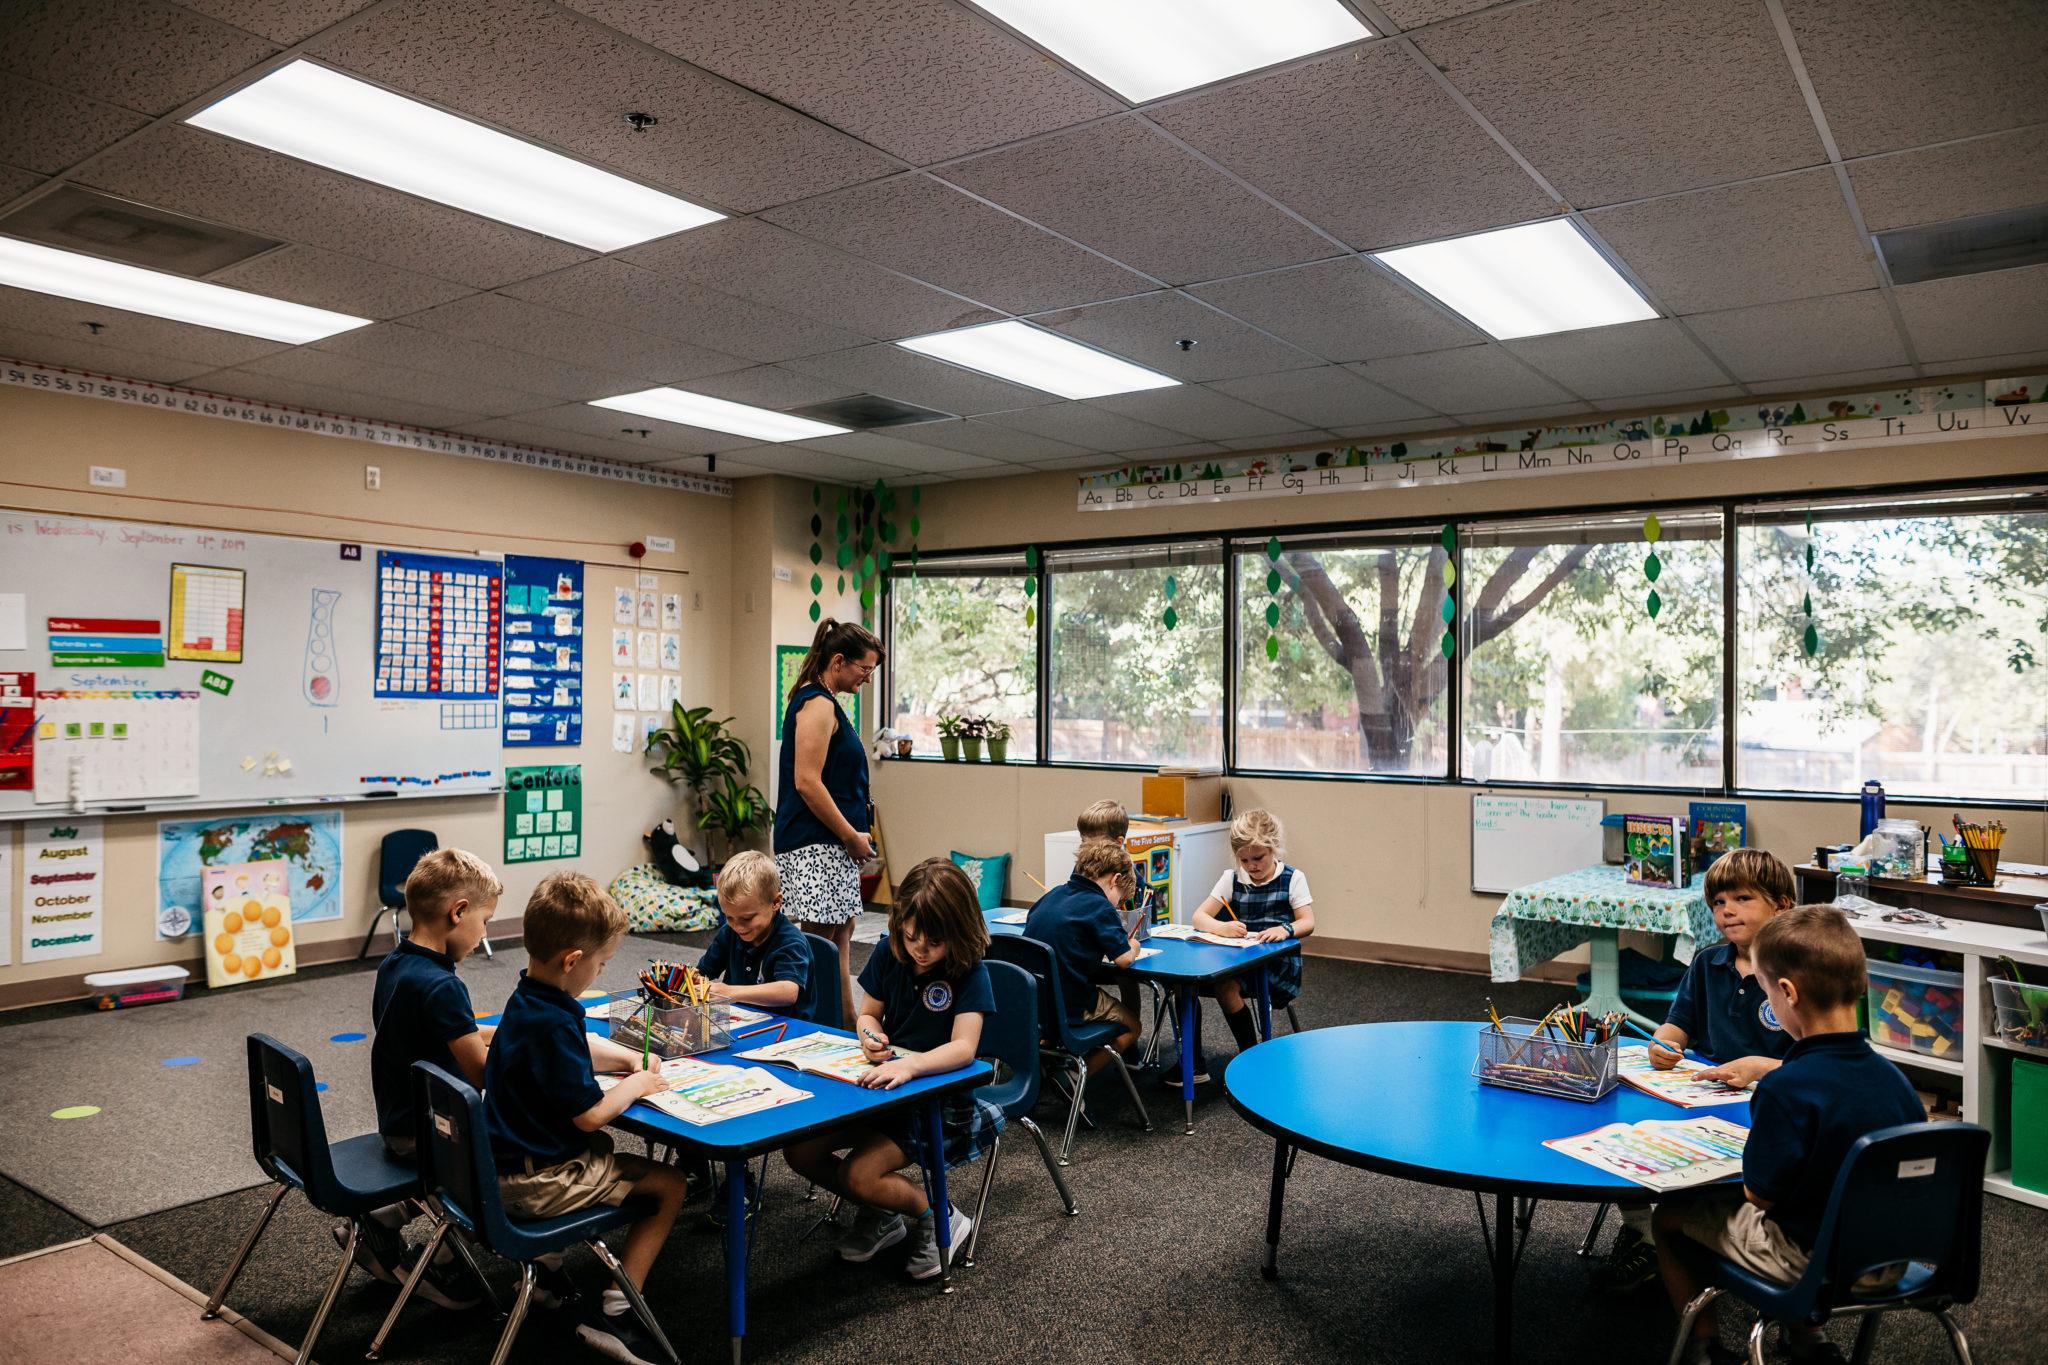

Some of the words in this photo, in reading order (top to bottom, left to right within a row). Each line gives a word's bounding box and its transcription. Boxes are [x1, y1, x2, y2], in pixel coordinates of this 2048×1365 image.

[8, 369, 25, 382] 54
[32, 374, 49, 386] 55
[55, 378, 72, 390] 56
[78, 381, 94, 394] 57
[100, 384, 116, 398] 58
[122, 388, 138, 400] 59
[142, 392, 159, 404] 60
[165, 396, 176, 407] 61
[184, 400, 198, 412] 62
[203, 403, 217, 414] 63
[223, 406, 236, 417] 64
[242, 409, 254, 420] 65
[260, 412, 273, 424] 66
[278, 414, 290, 426] 67
[296, 418, 309, 429] 68
[314, 420, 326, 432] 69
[330, 423, 344, 435] 70
[350, 426, 357, 436] 71
[364, 428, 376, 440] 72
[381, 432, 391, 442] 73
[397, 434, 406, 444] 74
[412, 436, 422, 447] 75
[426, 439, 437, 449] 76
[442, 441, 452, 451] 77
[456, 444, 466, 454] 78
[472, 446, 481, 456] 79
[484, 448, 496, 458] 80
[500, 450, 508, 460] 81
[512, 452, 523, 462] 82
[526, 454, 536, 464] 83
[539, 456, 548, 465] 84
[552, 458, 562, 468] 85
[564, 461, 574, 470] 86
[577, 463, 586, 472] 87
[590, 464, 598, 474] 88
[602, 467, 610, 476] 89
[1084, 491, 1102, 504] Aa
[1116, 488, 1133, 502] Bb
[1148, 486, 1164, 500] Cc
[1180, 482, 1198, 498] Dd
[1214, 480, 1230, 494] Ee
[1248, 476, 1266, 492] Ff
[1282, 473, 1304, 494] Gg
[1320, 470, 1340, 486] Hh
[1364, 467, 1374, 482] Ii
[1398, 462, 1415, 482] Jj
[1438, 460, 1459, 476] Kk
[1482, 456, 1497, 472] Ll
[1519, 452, 1550, 469] Mm
[1568, 448, 1592, 464] Nn
[1614, 444, 1640, 460] Oo
[1664, 438, 1688, 462] Pp
[1712, 434, 1742, 456] Qq
[1768, 428, 1793, 446] Rr
[1822, 423, 1848, 442] Ss
[1880, 417, 1906, 436] Tt
[1938, 412, 1968, 431] Uu
[2004, 406, 2031, 425] Vv
[119, 528, 185, 548] September
[344, 548, 358, 558] AB
[71, 674, 148, 689] September
[205, 675, 228, 690] ABB
[508, 767, 580, 791] Centers
[49, 826, 78, 839] July
[1626, 821, 1672, 836] INSECTS
[1131, 838, 1140, 847] The
[1142, 837, 1152, 845] Five
[1153, 835, 1171, 844] Senses
[40, 846, 88, 860] August
[30, 872, 96, 886] September
[35, 895, 92, 907] October
[32, 911, 94, 924] November
[31, 934, 94, 948] December
